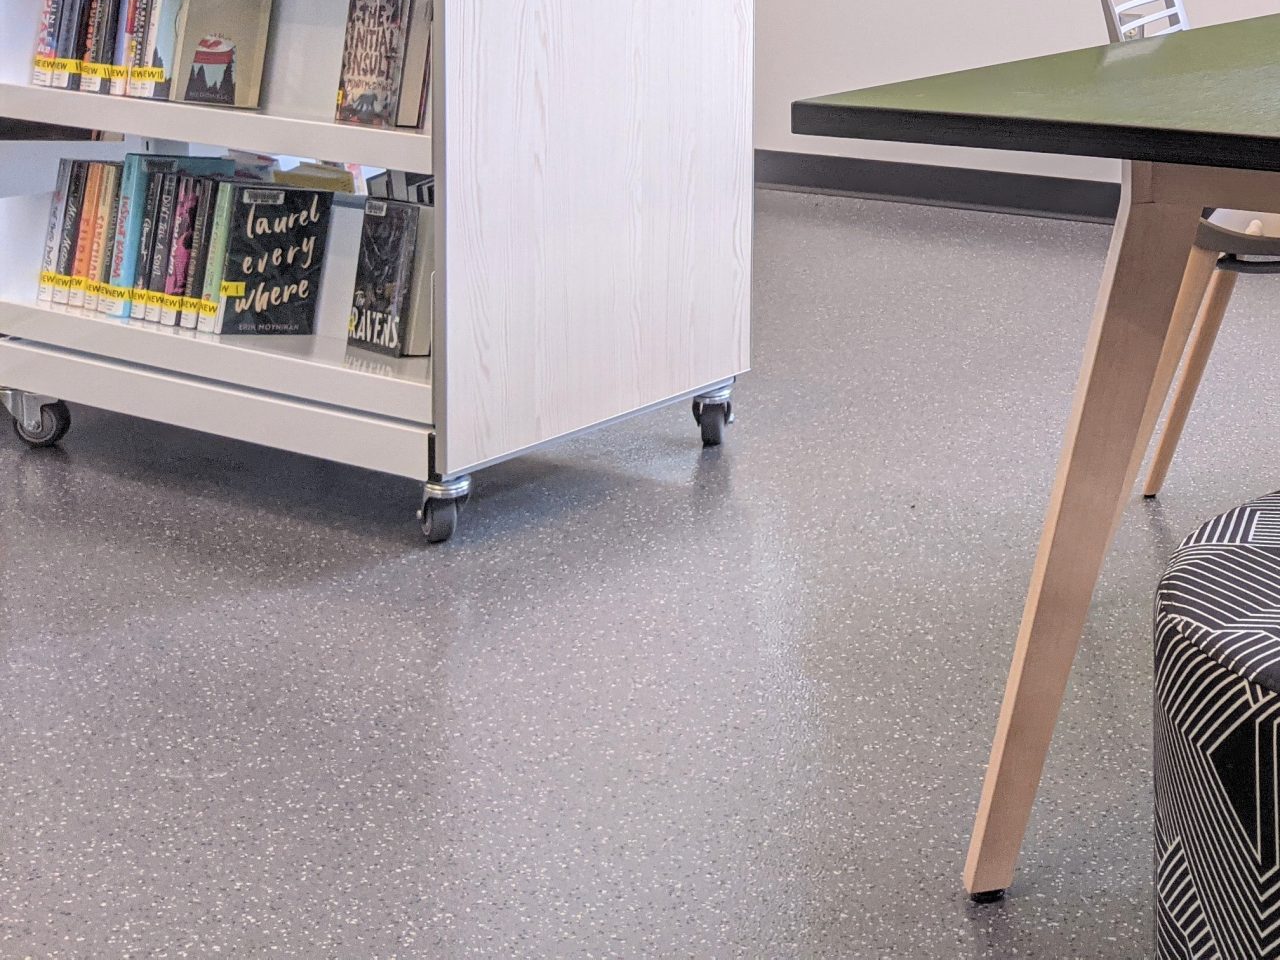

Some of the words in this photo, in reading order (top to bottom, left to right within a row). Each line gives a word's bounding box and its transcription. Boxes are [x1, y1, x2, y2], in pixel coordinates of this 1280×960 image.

[358, 3, 387, 28] THE
[345, 51, 393, 81] INSULT
[246, 194, 320, 239] laurel
[151, 254, 163, 277] SOUL
[242, 236, 317, 275] every
[234, 279, 309, 314] where
[348, 306, 400, 349] RAVENS
